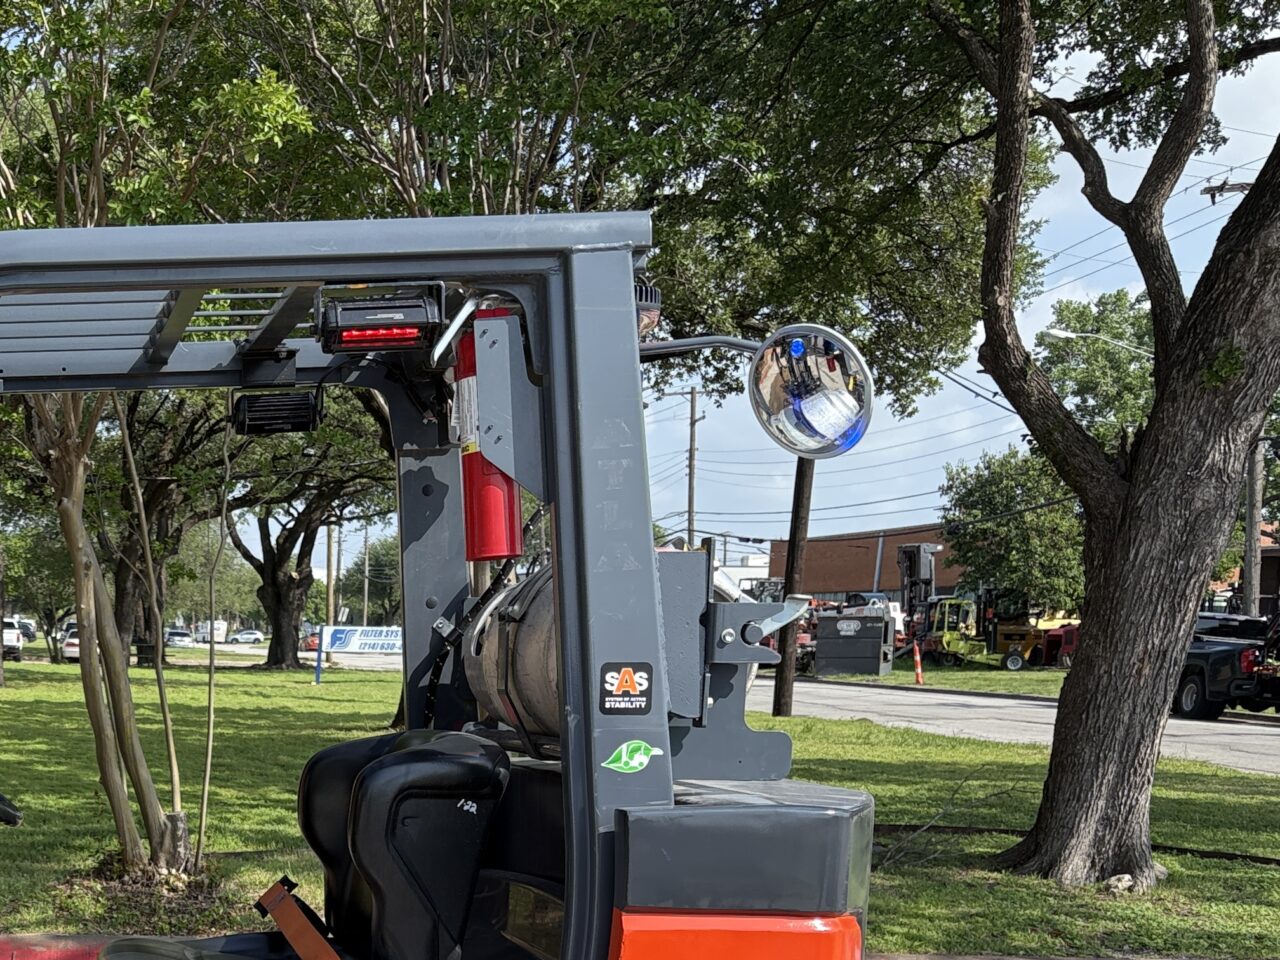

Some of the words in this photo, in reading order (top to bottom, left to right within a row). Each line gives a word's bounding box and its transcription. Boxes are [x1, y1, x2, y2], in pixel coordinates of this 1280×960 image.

[359, 629, 383, 639] FILTER
[384, 629, 402, 638] SYS
[358, 642, 379, 651] (214)
[604, 667, 649, 695] SAS
